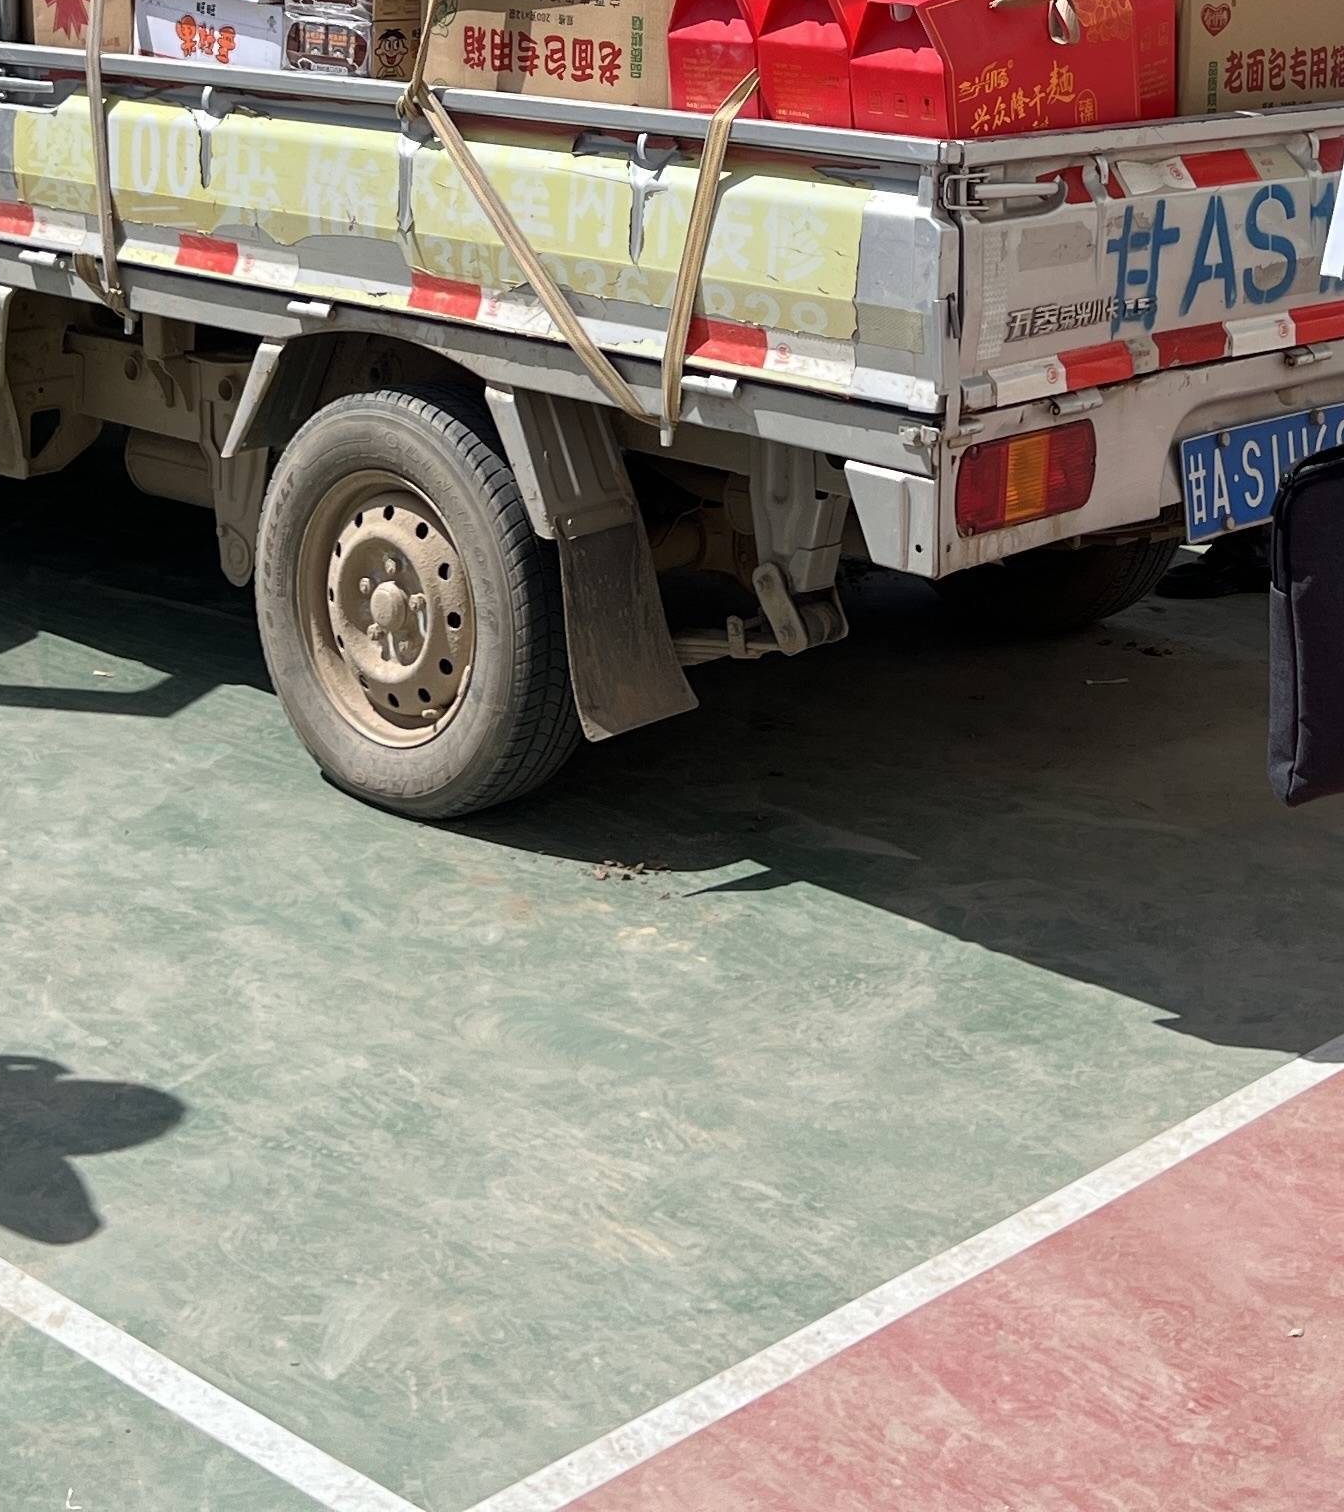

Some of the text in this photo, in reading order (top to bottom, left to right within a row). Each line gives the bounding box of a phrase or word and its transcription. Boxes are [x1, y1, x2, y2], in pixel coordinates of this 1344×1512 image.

[463, 25, 623, 87] 老面包专用箱
